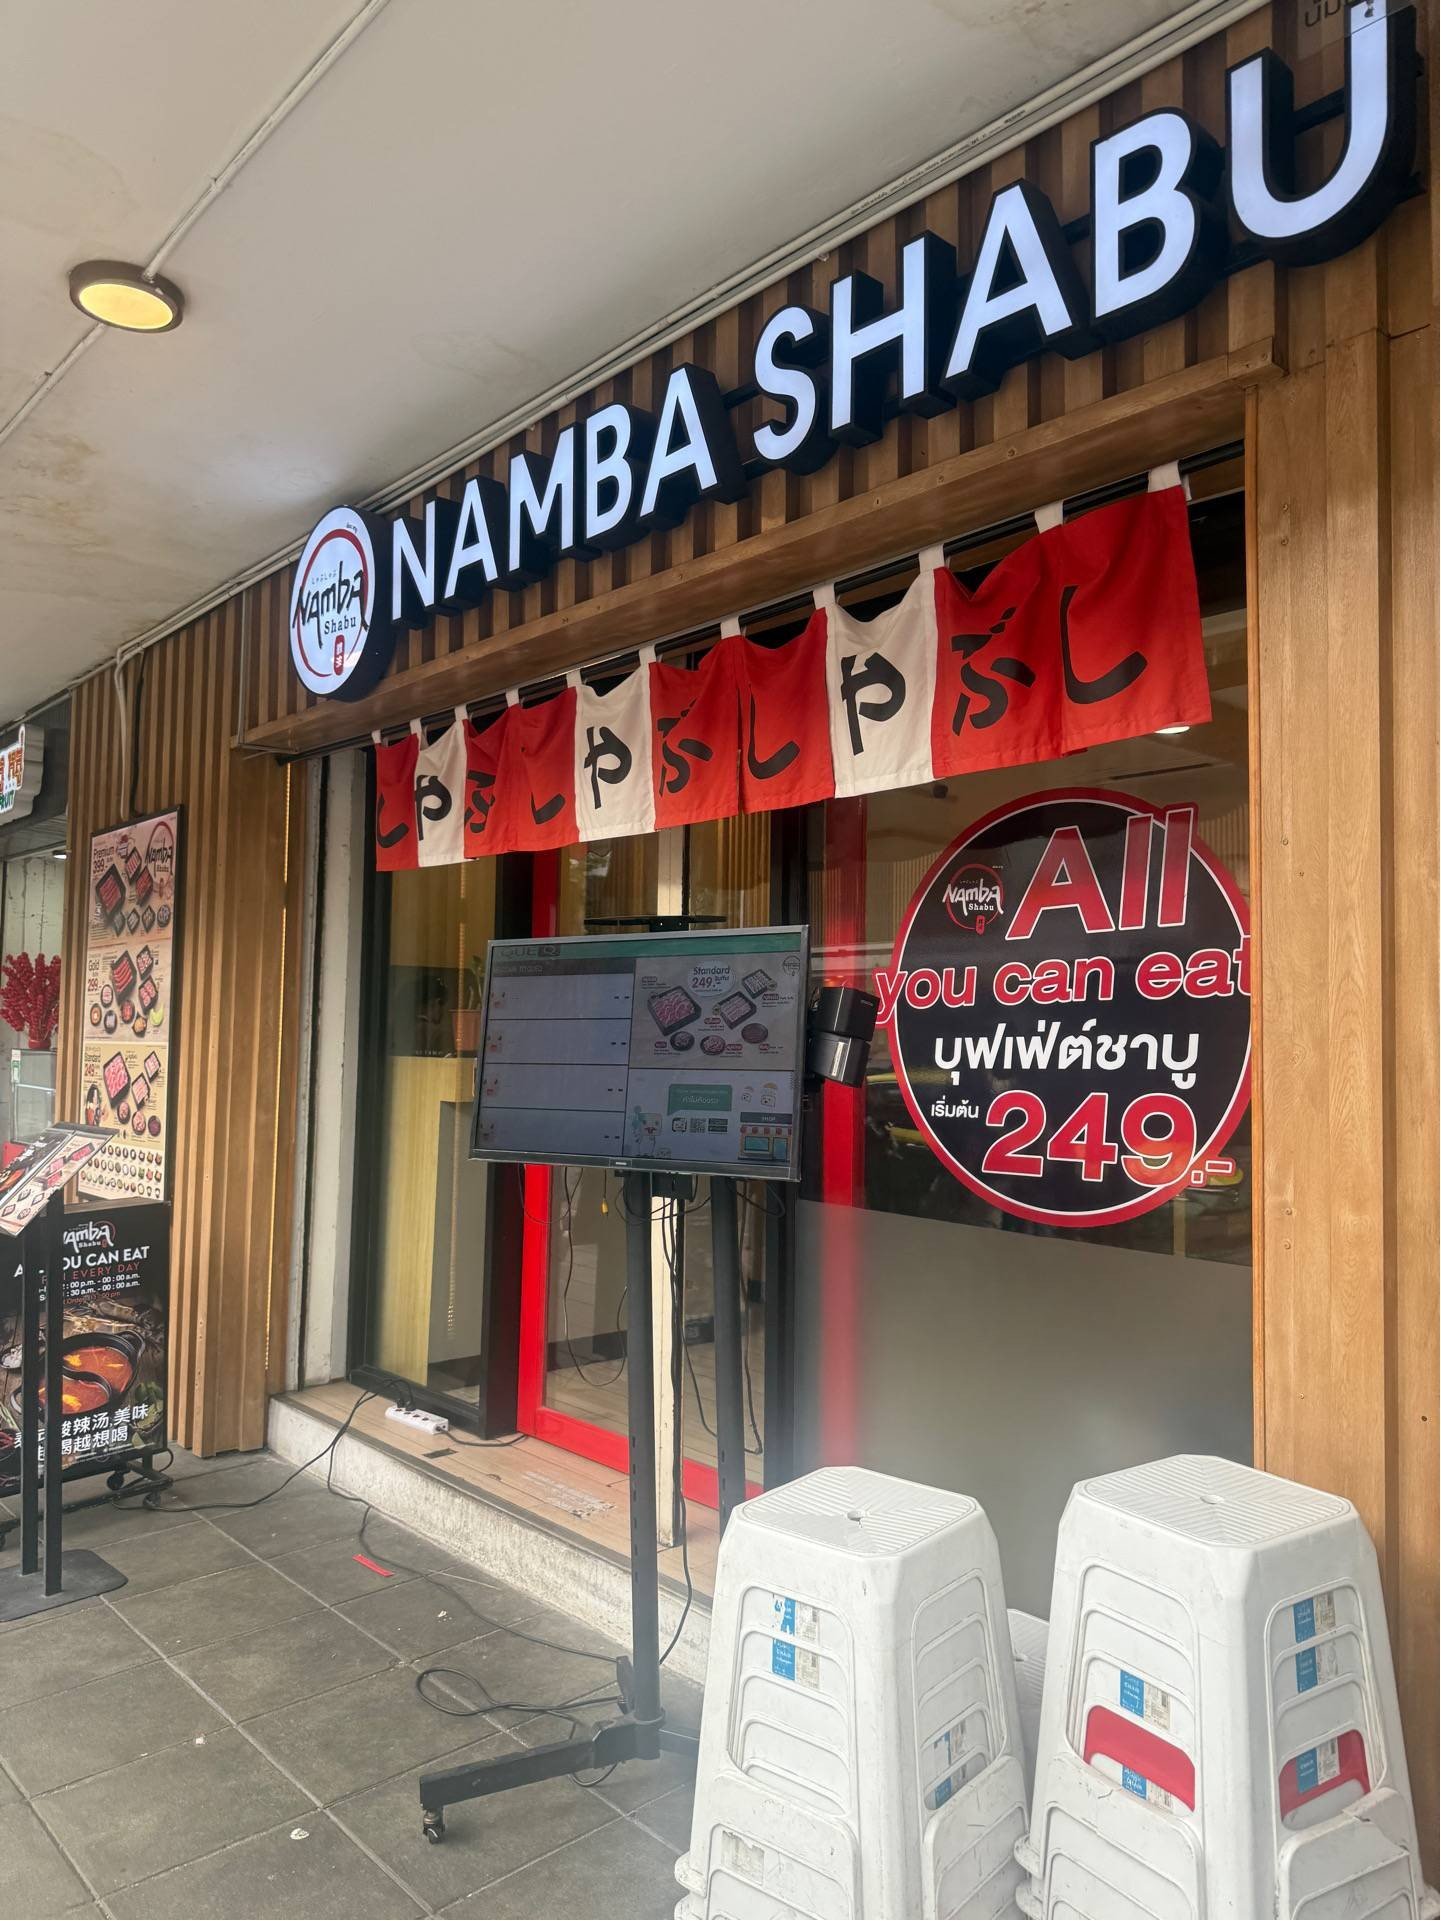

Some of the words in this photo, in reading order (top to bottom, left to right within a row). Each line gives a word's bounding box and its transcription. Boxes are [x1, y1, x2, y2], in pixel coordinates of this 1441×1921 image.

[391, 367, 718, 622] NAMBA
[752, 0, 1388, 461] SHABU
[323, 615, 356, 635] Shabu
[1005, 807, 1195, 941] All
[968, 903, 995, 911] Shabu
[693, 965, 731, 975] Standard
[873, 966, 977, 1024] you
[993, 955, 1114, 1005] can
[1135, 945, 1251, 1000] eat
[934, 1018, 1200, 1088] บุฟเฟ่ต์ชาบู
[930, 1100, 980, 1119] เริ่มต้น
[85, 1249, 120, 1267] CAN
[123, 1245, 150, 1261] EAT
[73, 1266, 112, 1280] EVERY
[117, 1261, 140, 1273] DAY
